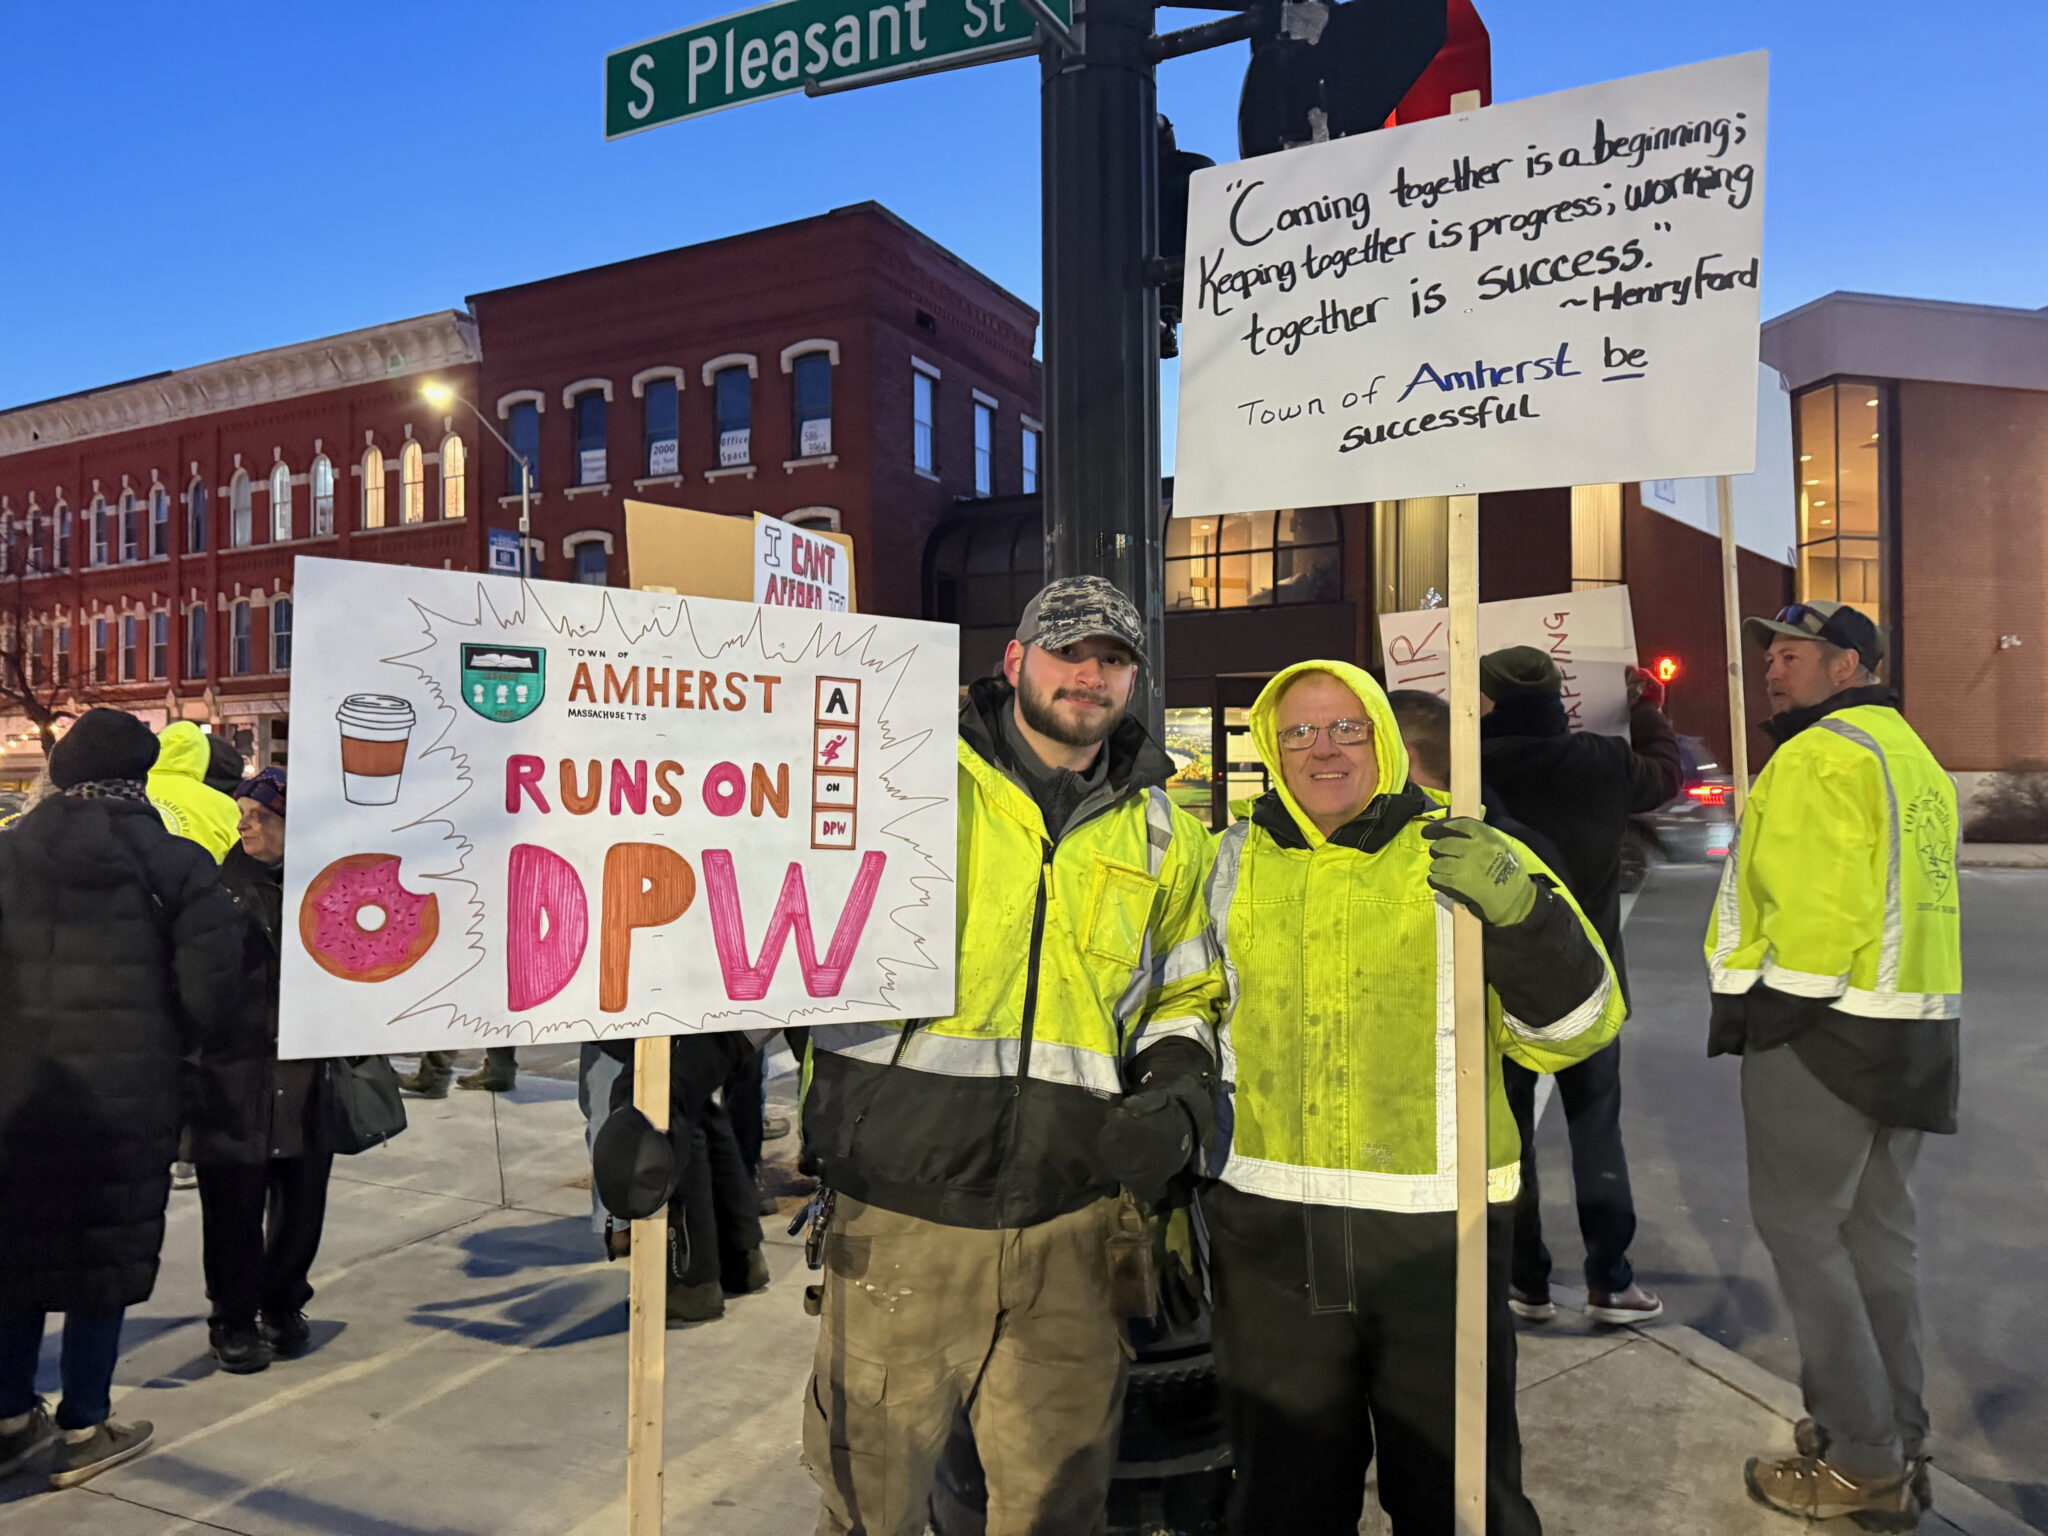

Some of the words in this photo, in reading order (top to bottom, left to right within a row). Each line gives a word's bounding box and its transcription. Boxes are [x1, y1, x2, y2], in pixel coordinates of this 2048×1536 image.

[627, 53, 655, 120] S
[688, 0, 927, 105] Pleasant
[963, 0, 1006, 38] St
[1390, 155, 1513, 209] together
[1526, 144, 1554, 179] is
[1558, 147, 1594, 168] a
[1594, 112, 1748, 168] beginning;
[1198, 247, 1297, 317] Keeping
[1301, 227, 1417, 280] together
[1428, 218, 1463, 251] is
[1468, 182, 1617, 252] progress;
[1624, 163, 1755, 210] working
[1694, 252, 1759, 300] Ford
[1240, 298, 1390, 356] together
[1409, 277, 1447, 319] is
[1237, 397, 1326, 426] Town
[1341, 374, 1386, 409] of
[1396, 341, 1582, 403] Amherst
[1602, 335, 1649, 369] be
[720, 436, 748, 447] Office
[1338, 393, 1542, 454] successful
[653, 444, 676, 456] 2000
[721, 450, 748, 463] Space
[764, 524, 782, 568] I
[791, 532, 836, 586] CANT
[567, 648, 606, 658] TOWN
[617, 651, 629, 659] OF
[567, 661, 782, 713] AMHERST
[824, 687, 850, 715] A
[567, 708, 648, 721] MASSACHUSETTS
[505, 753, 686, 817] RUNS
[702, 760, 790, 819] ON
[825, 782, 840, 792] ON
[822, 820, 848, 837] DPW
[506, 841, 888, 1012] DPW
